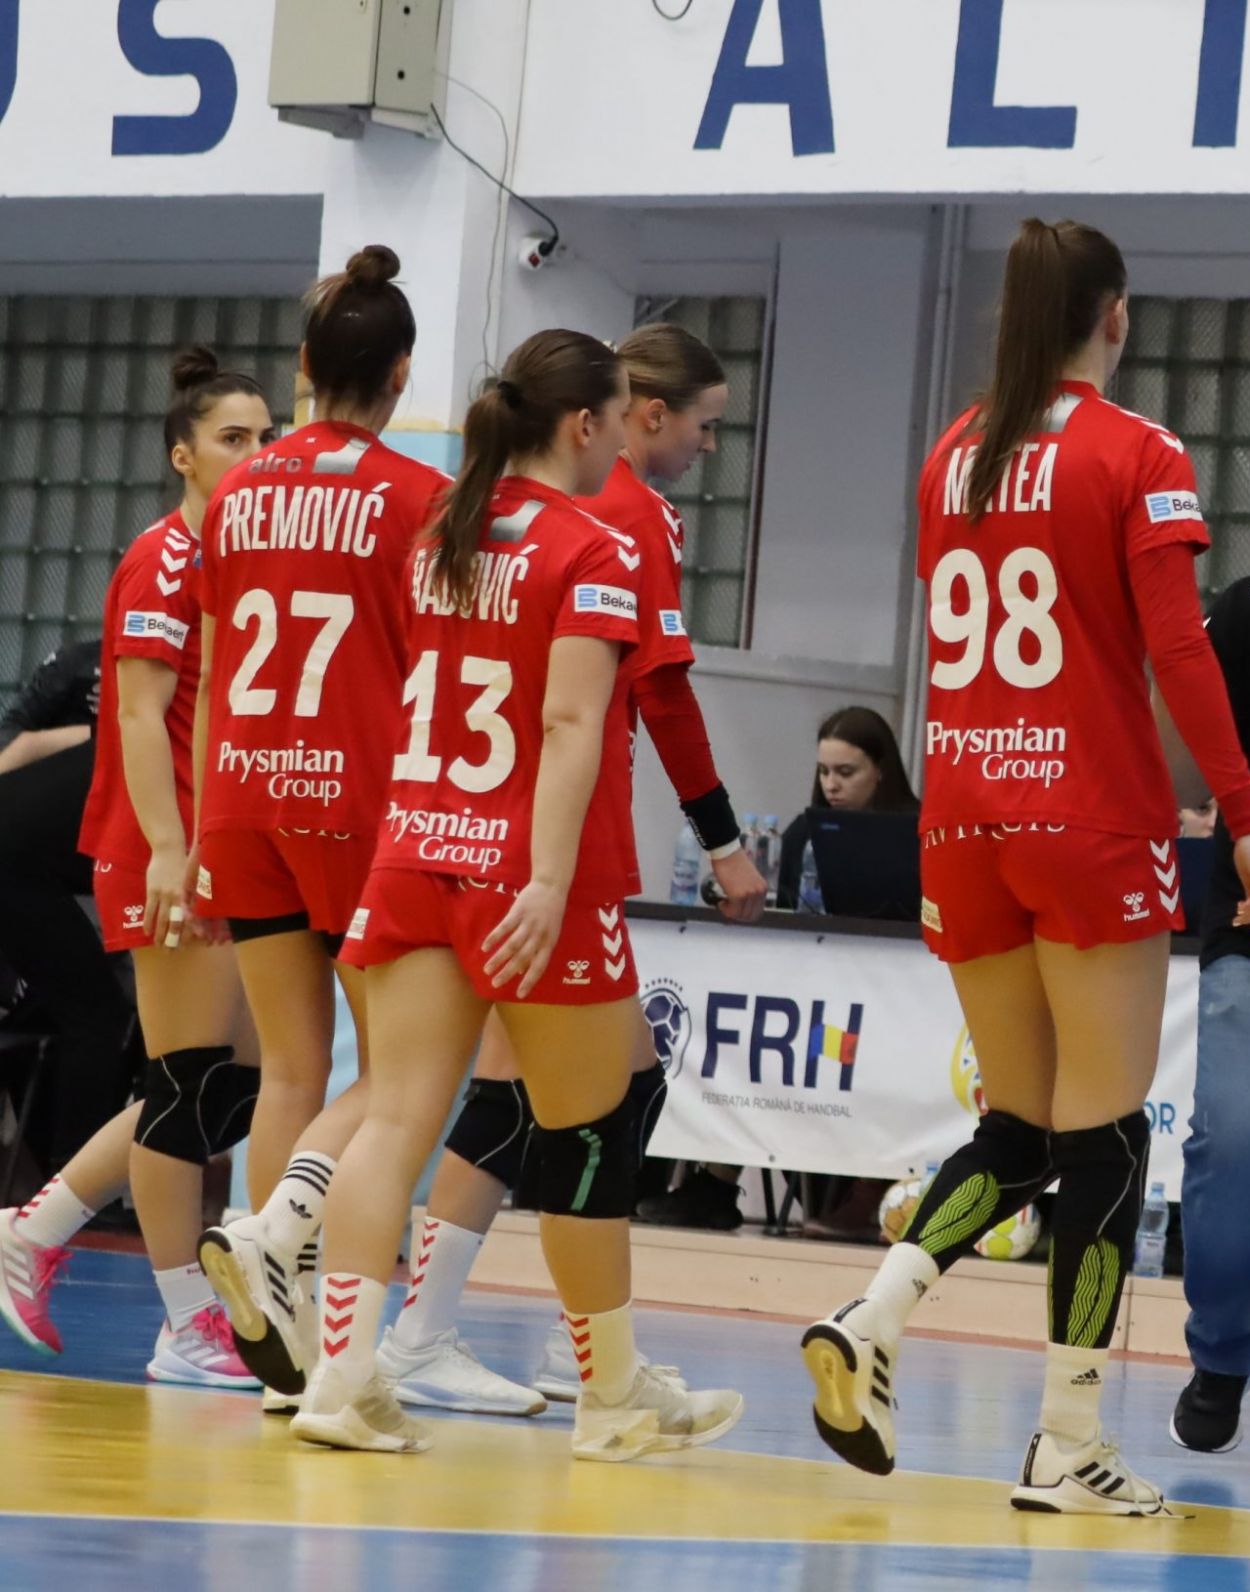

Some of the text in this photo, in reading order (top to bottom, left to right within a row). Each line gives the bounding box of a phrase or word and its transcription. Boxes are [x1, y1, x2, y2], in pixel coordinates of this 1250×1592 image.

[220, 481, 393, 558] PREMOVIĆ
[228, 588, 355, 717] 27
[930, 547, 1063, 690] 98
[391, 650, 516, 793] 13
[927, 718, 1066, 766] Prysmian
[218, 740, 344, 784] Prysmian
[981, 753, 1064, 788] Group
[418, 835, 502, 874] Group
[701, 992, 864, 1092] FRH
